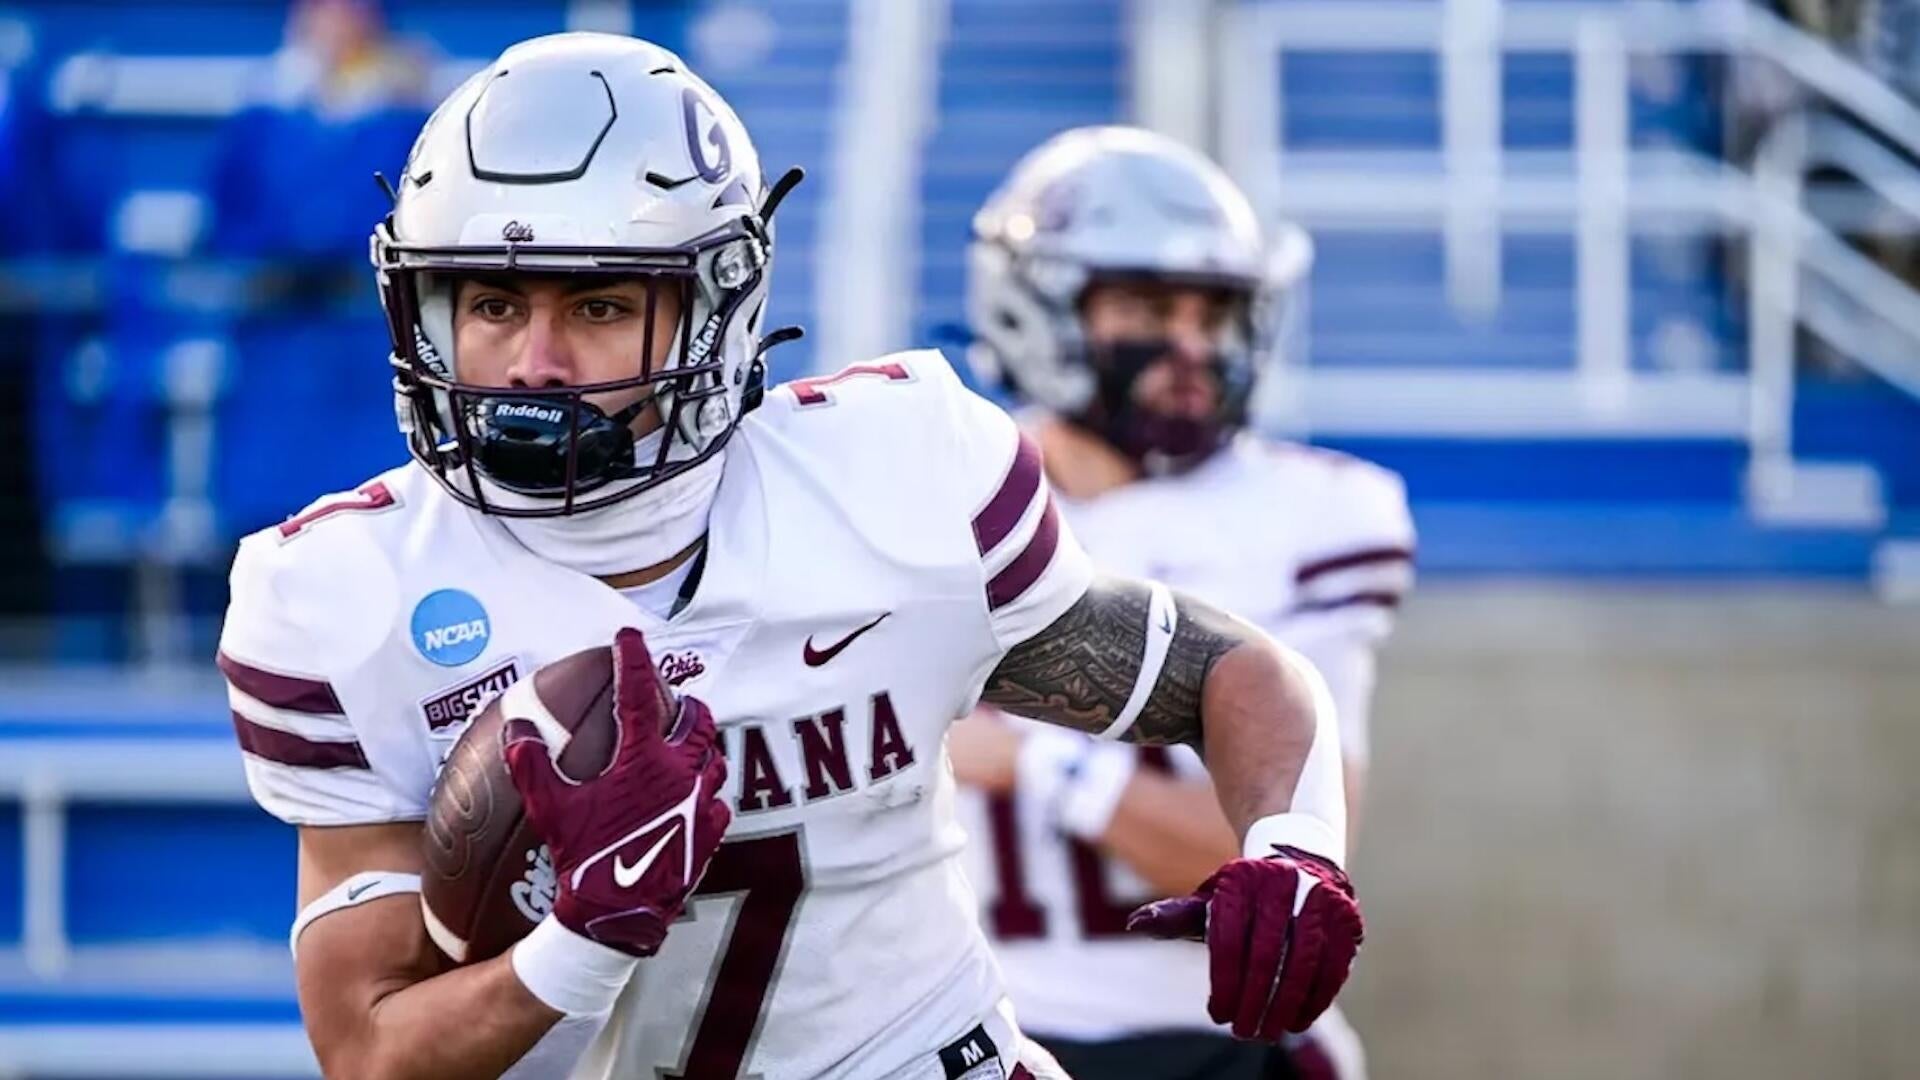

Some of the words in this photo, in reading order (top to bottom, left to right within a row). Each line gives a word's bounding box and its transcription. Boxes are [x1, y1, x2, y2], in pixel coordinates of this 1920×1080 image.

[495, 404, 563, 423] Riddell
[423, 619, 488, 651] NCAA
[659, 651, 705, 686] Griz
[716, 690, 916, 814] ANA
[655, 823, 812, 1080] 7
[960, 1039, 985, 1067] M
